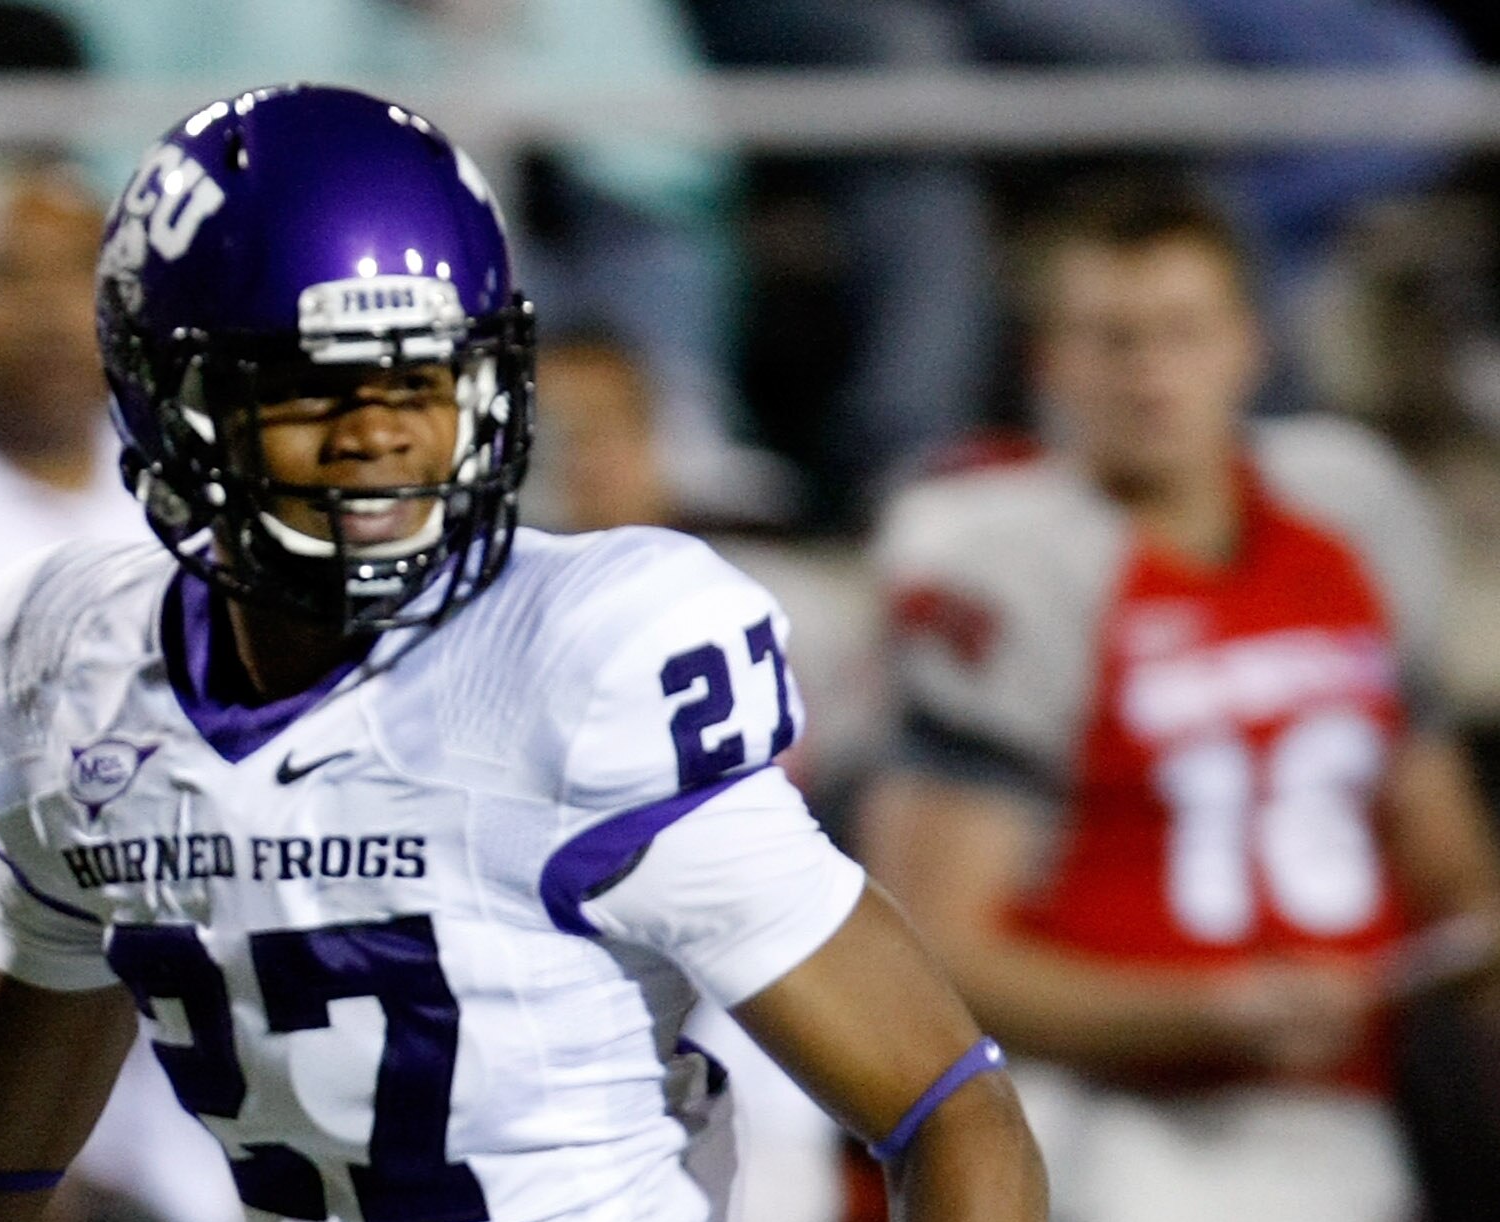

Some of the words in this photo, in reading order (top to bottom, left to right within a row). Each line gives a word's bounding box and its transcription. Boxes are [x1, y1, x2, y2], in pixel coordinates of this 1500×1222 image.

[120, 143, 226, 262] CU
[659, 614, 797, 795] 27
[62, 833, 236, 889] HORNED
[251, 834, 426, 881] FROGS
